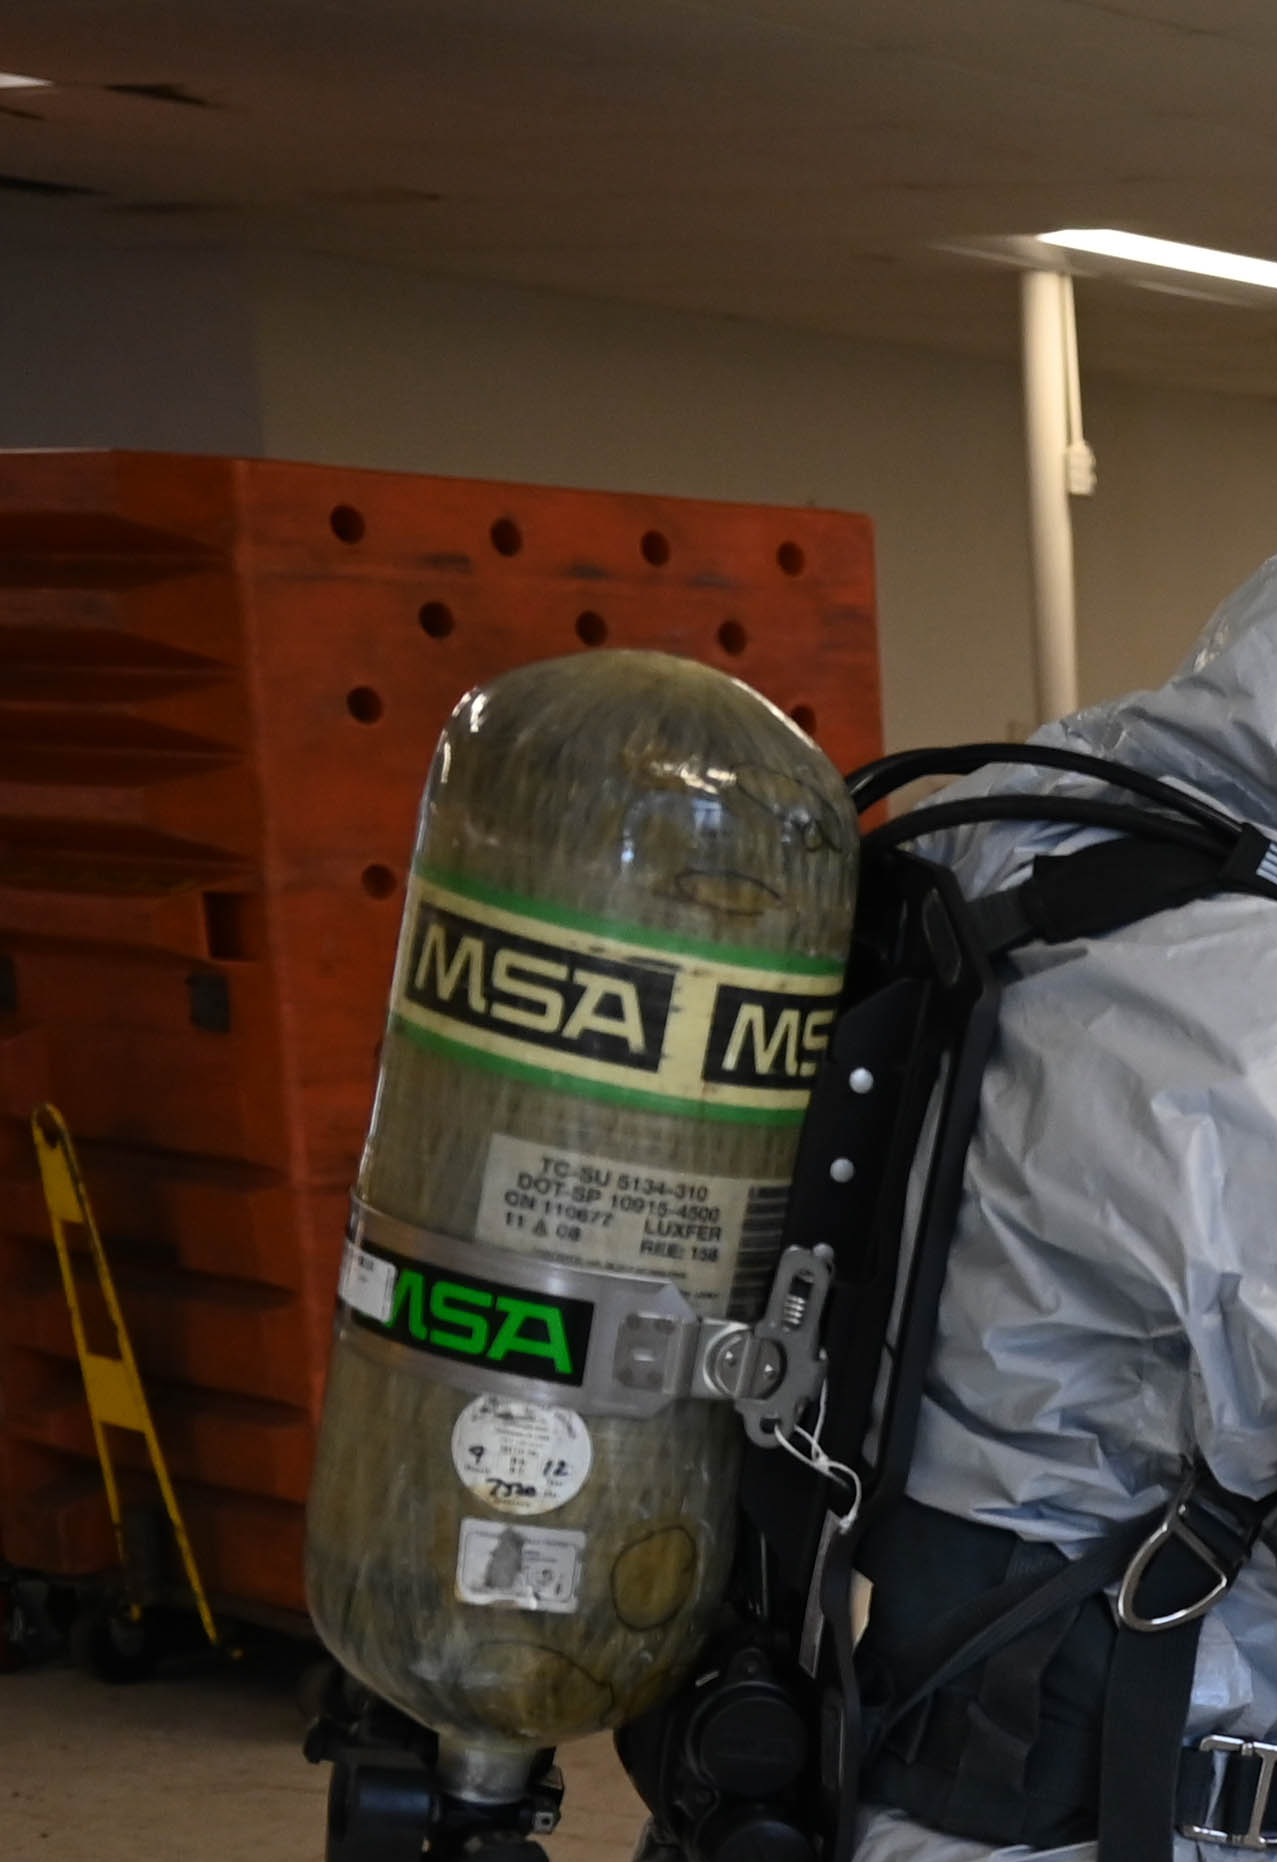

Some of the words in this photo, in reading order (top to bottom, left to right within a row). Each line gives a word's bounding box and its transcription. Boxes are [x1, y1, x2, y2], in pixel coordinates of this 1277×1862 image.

[413, 922, 646, 1054] MSA
[517, 1172, 601, 1202] DOT-SP
[617, 1173, 708, 1201] 5134-310
[643, 1218, 722, 1242] LUXFER
